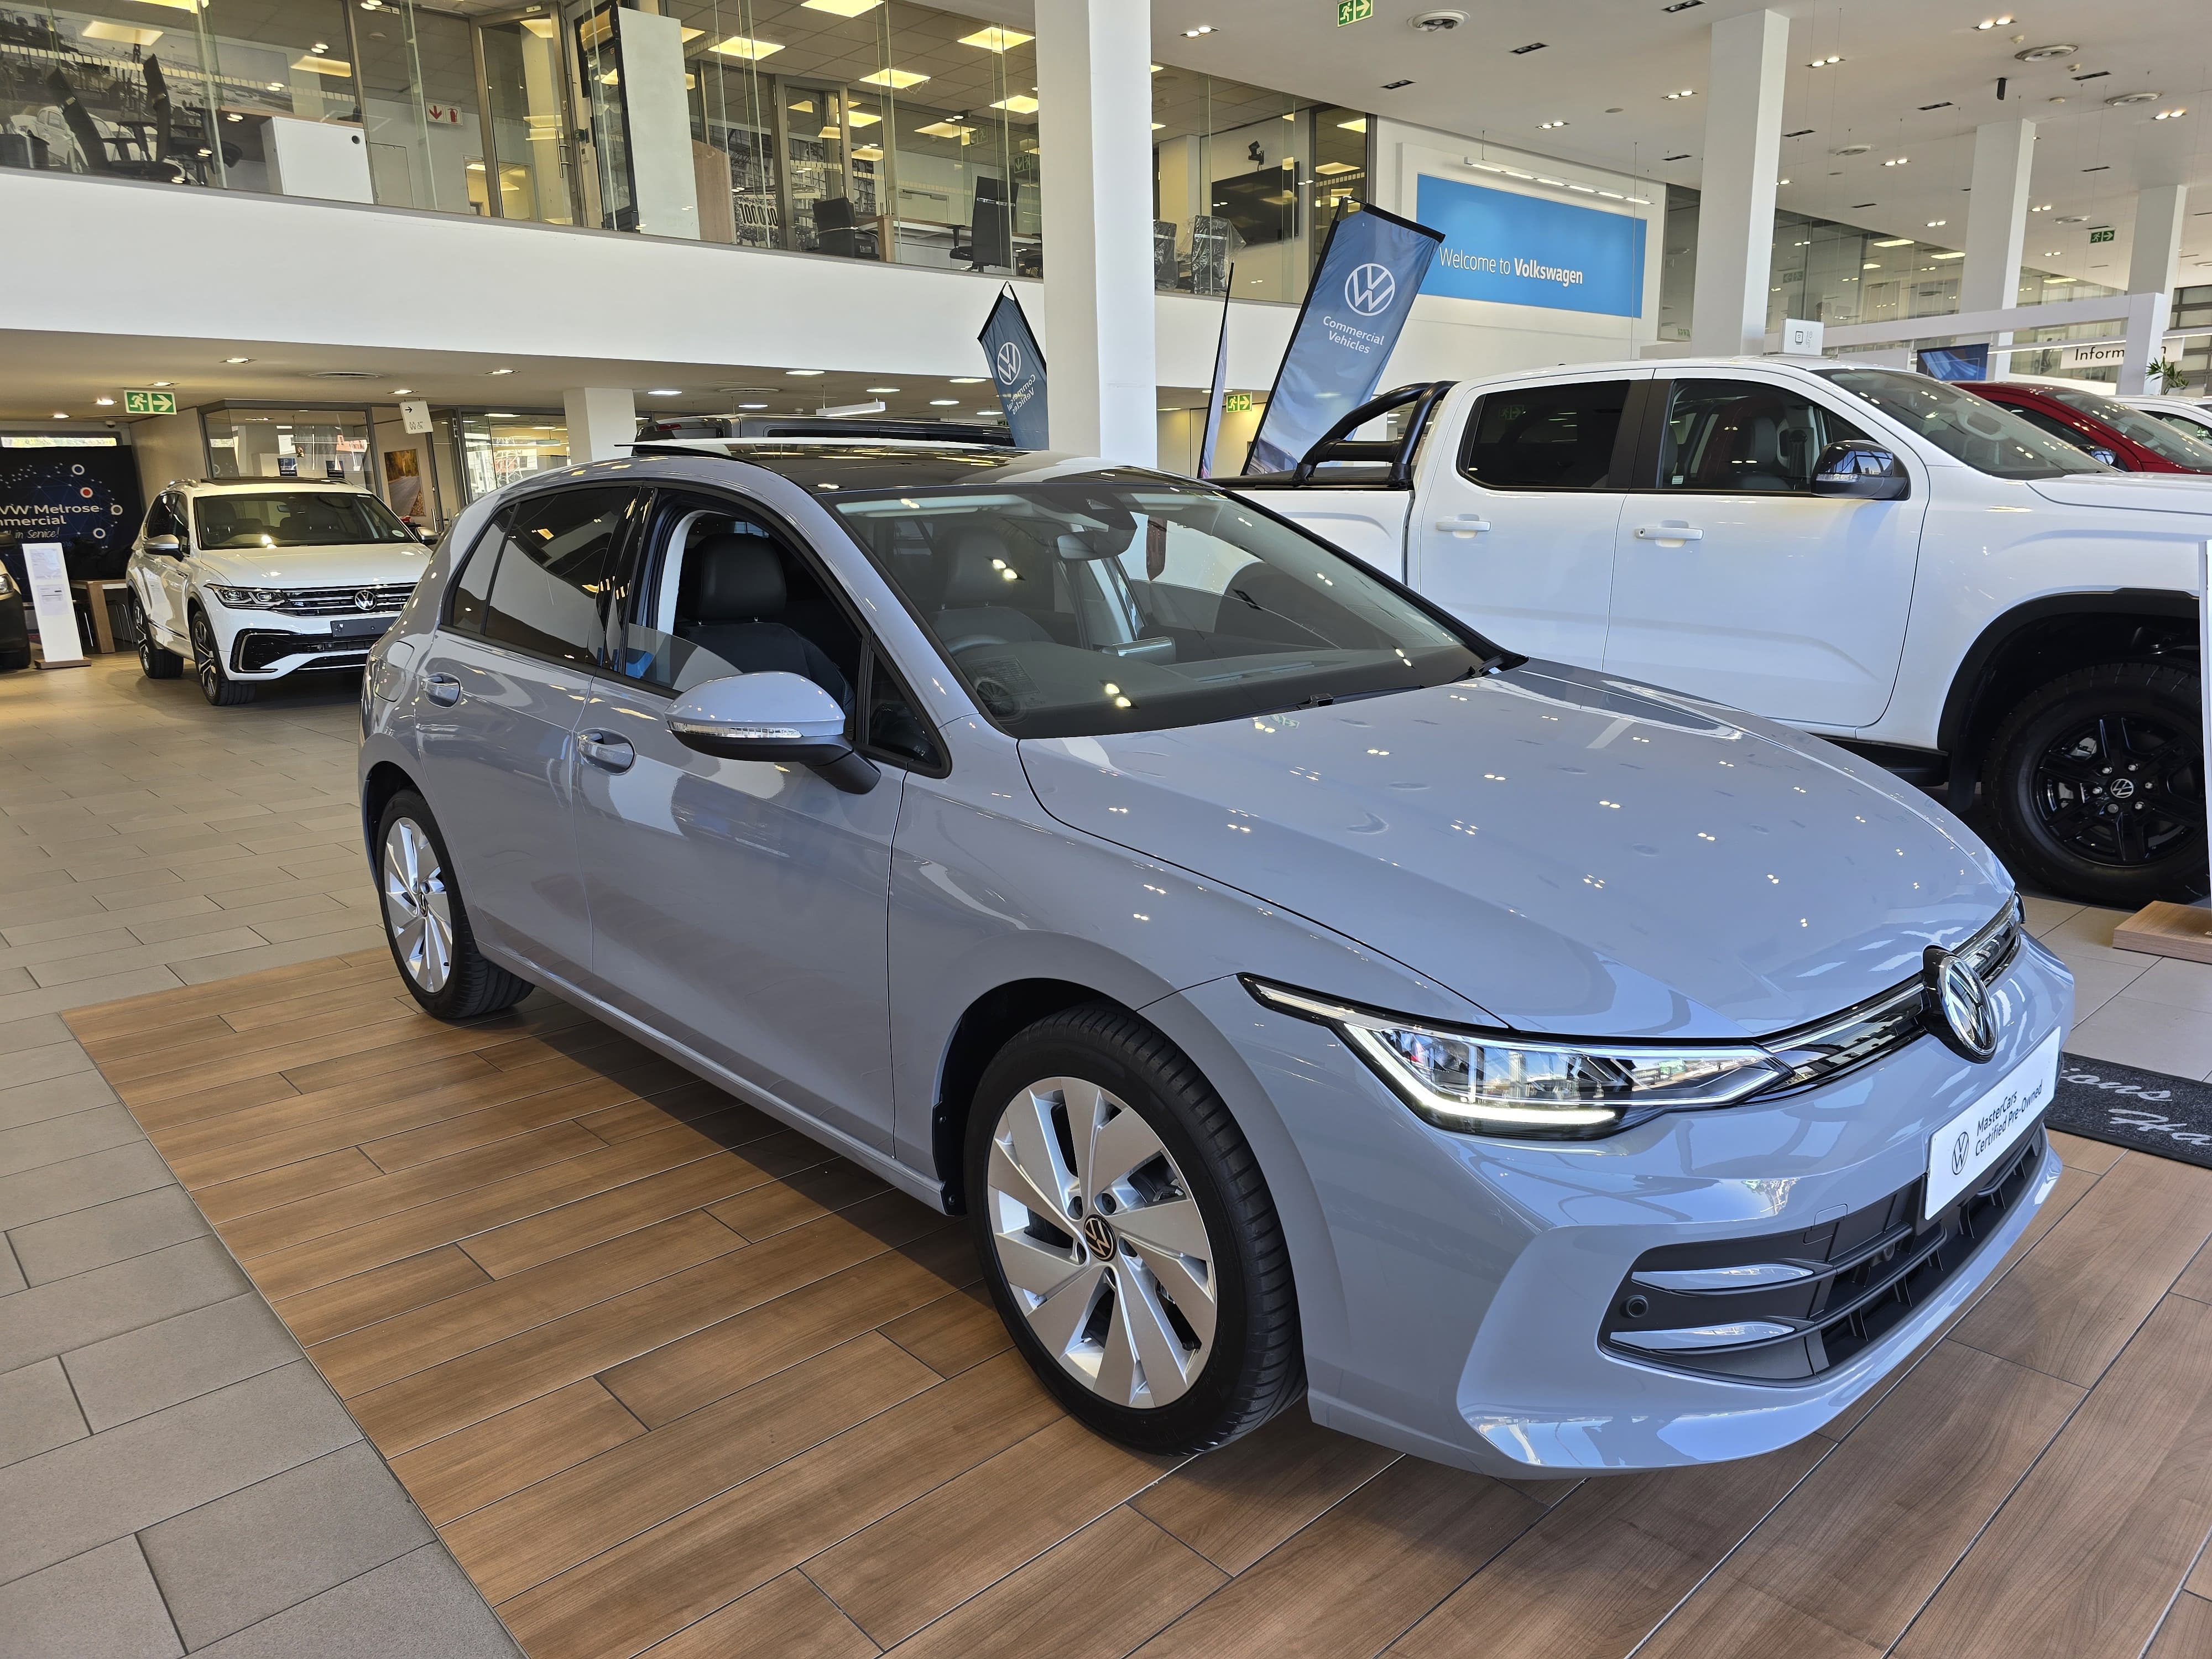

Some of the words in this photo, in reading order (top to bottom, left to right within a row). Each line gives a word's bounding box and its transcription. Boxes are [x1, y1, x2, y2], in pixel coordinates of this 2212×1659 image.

[1439, 247, 1496, 273] Welcome
[1499, 258, 1510, 275] to
[1514, 258, 1583, 287] Volkswagen
[1345, 263, 1395, 316] VW
[1323, 316, 1385, 346] Commercial
[1328, 330, 1370, 354] Vehicles
[34, 504, 100, 514] Melrose
[27, 526, 60, 538] Service!
[354, 590, 377, 611] VW
[1975, 1115, 2007, 1156] Certified
[2008, 1079, 2043, 1128] Pre-Owned
[1976, 1091, 2017, 1136] MasterCars
[1952, 1131, 1969, 1176] VW
[1084, 1217, 1114, 1260] VW
